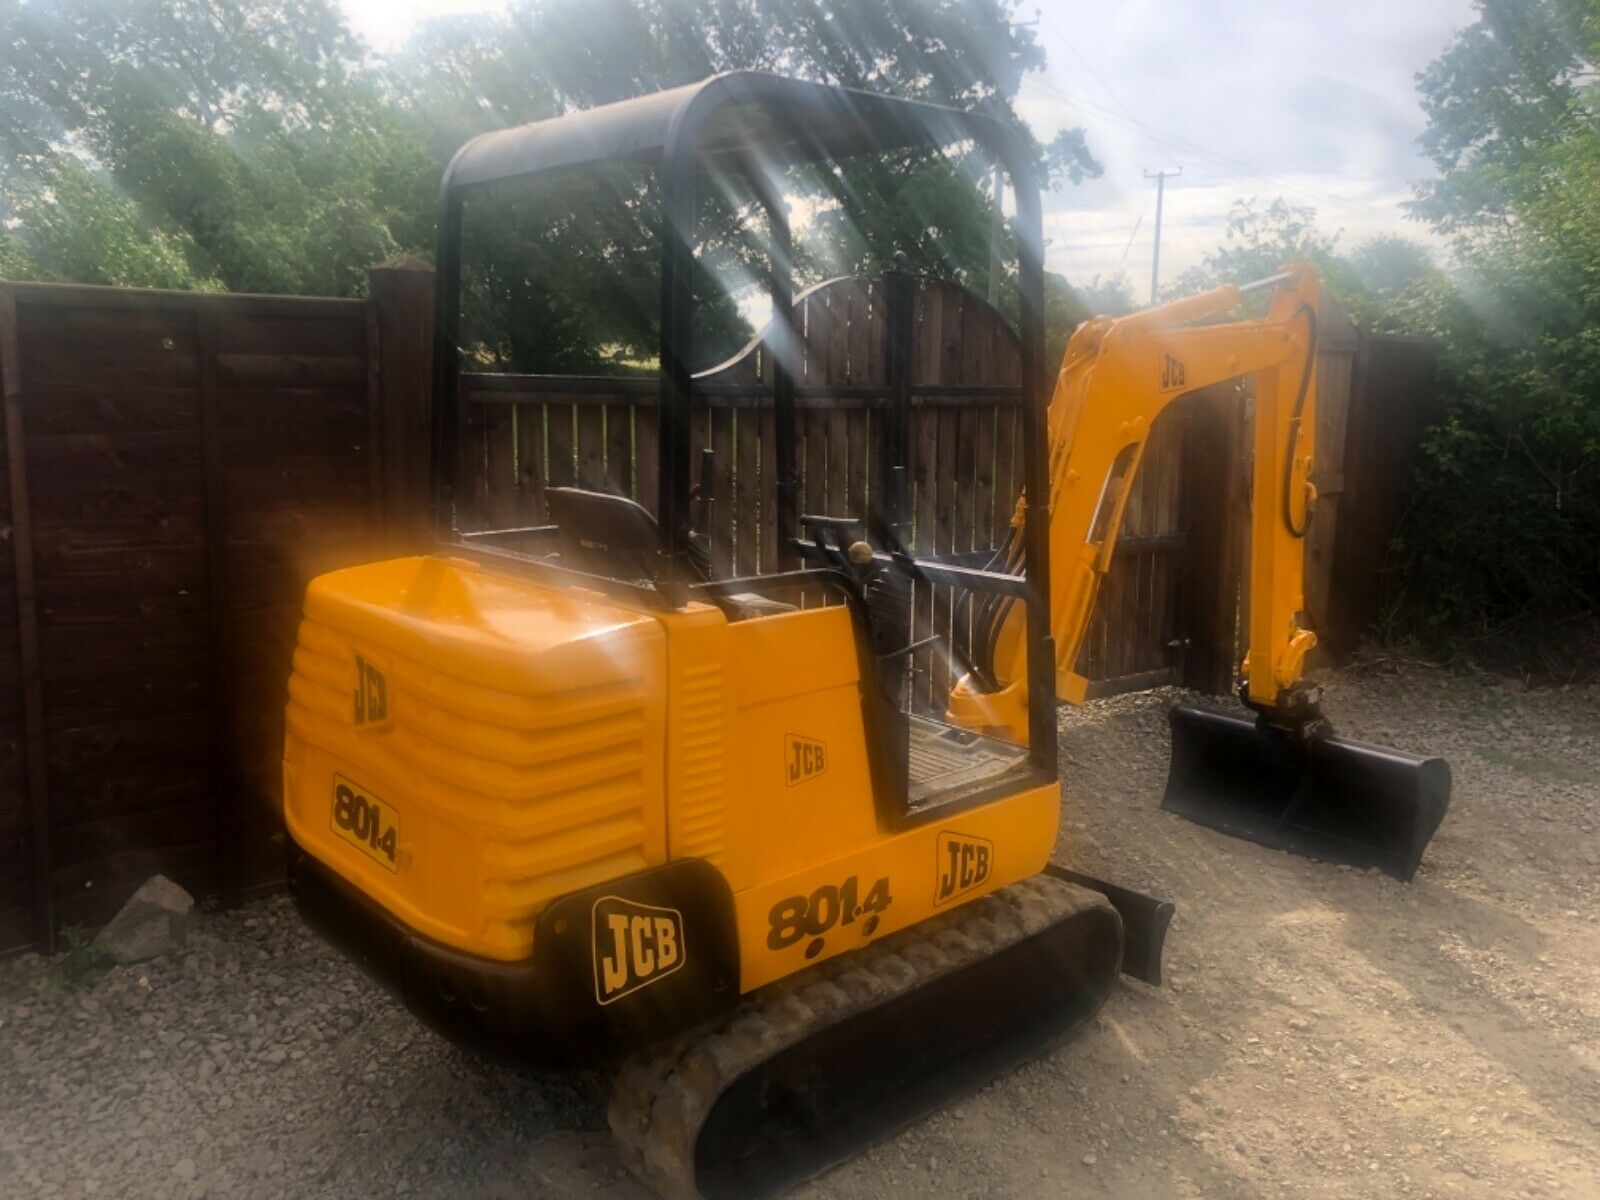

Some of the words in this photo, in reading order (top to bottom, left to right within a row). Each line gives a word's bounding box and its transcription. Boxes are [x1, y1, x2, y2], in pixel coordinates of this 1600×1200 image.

[1163, 355, 1186, 387] JCB
[353, 655, 387, 725] JCB
[790, 741, 824, 780] JCB
[335, 785, 397, 862] 801.4
[941, 841, 989, 899] JCB
[767, 876, 892, 950] 801.4
[603, 914, 677, 994] JCB
